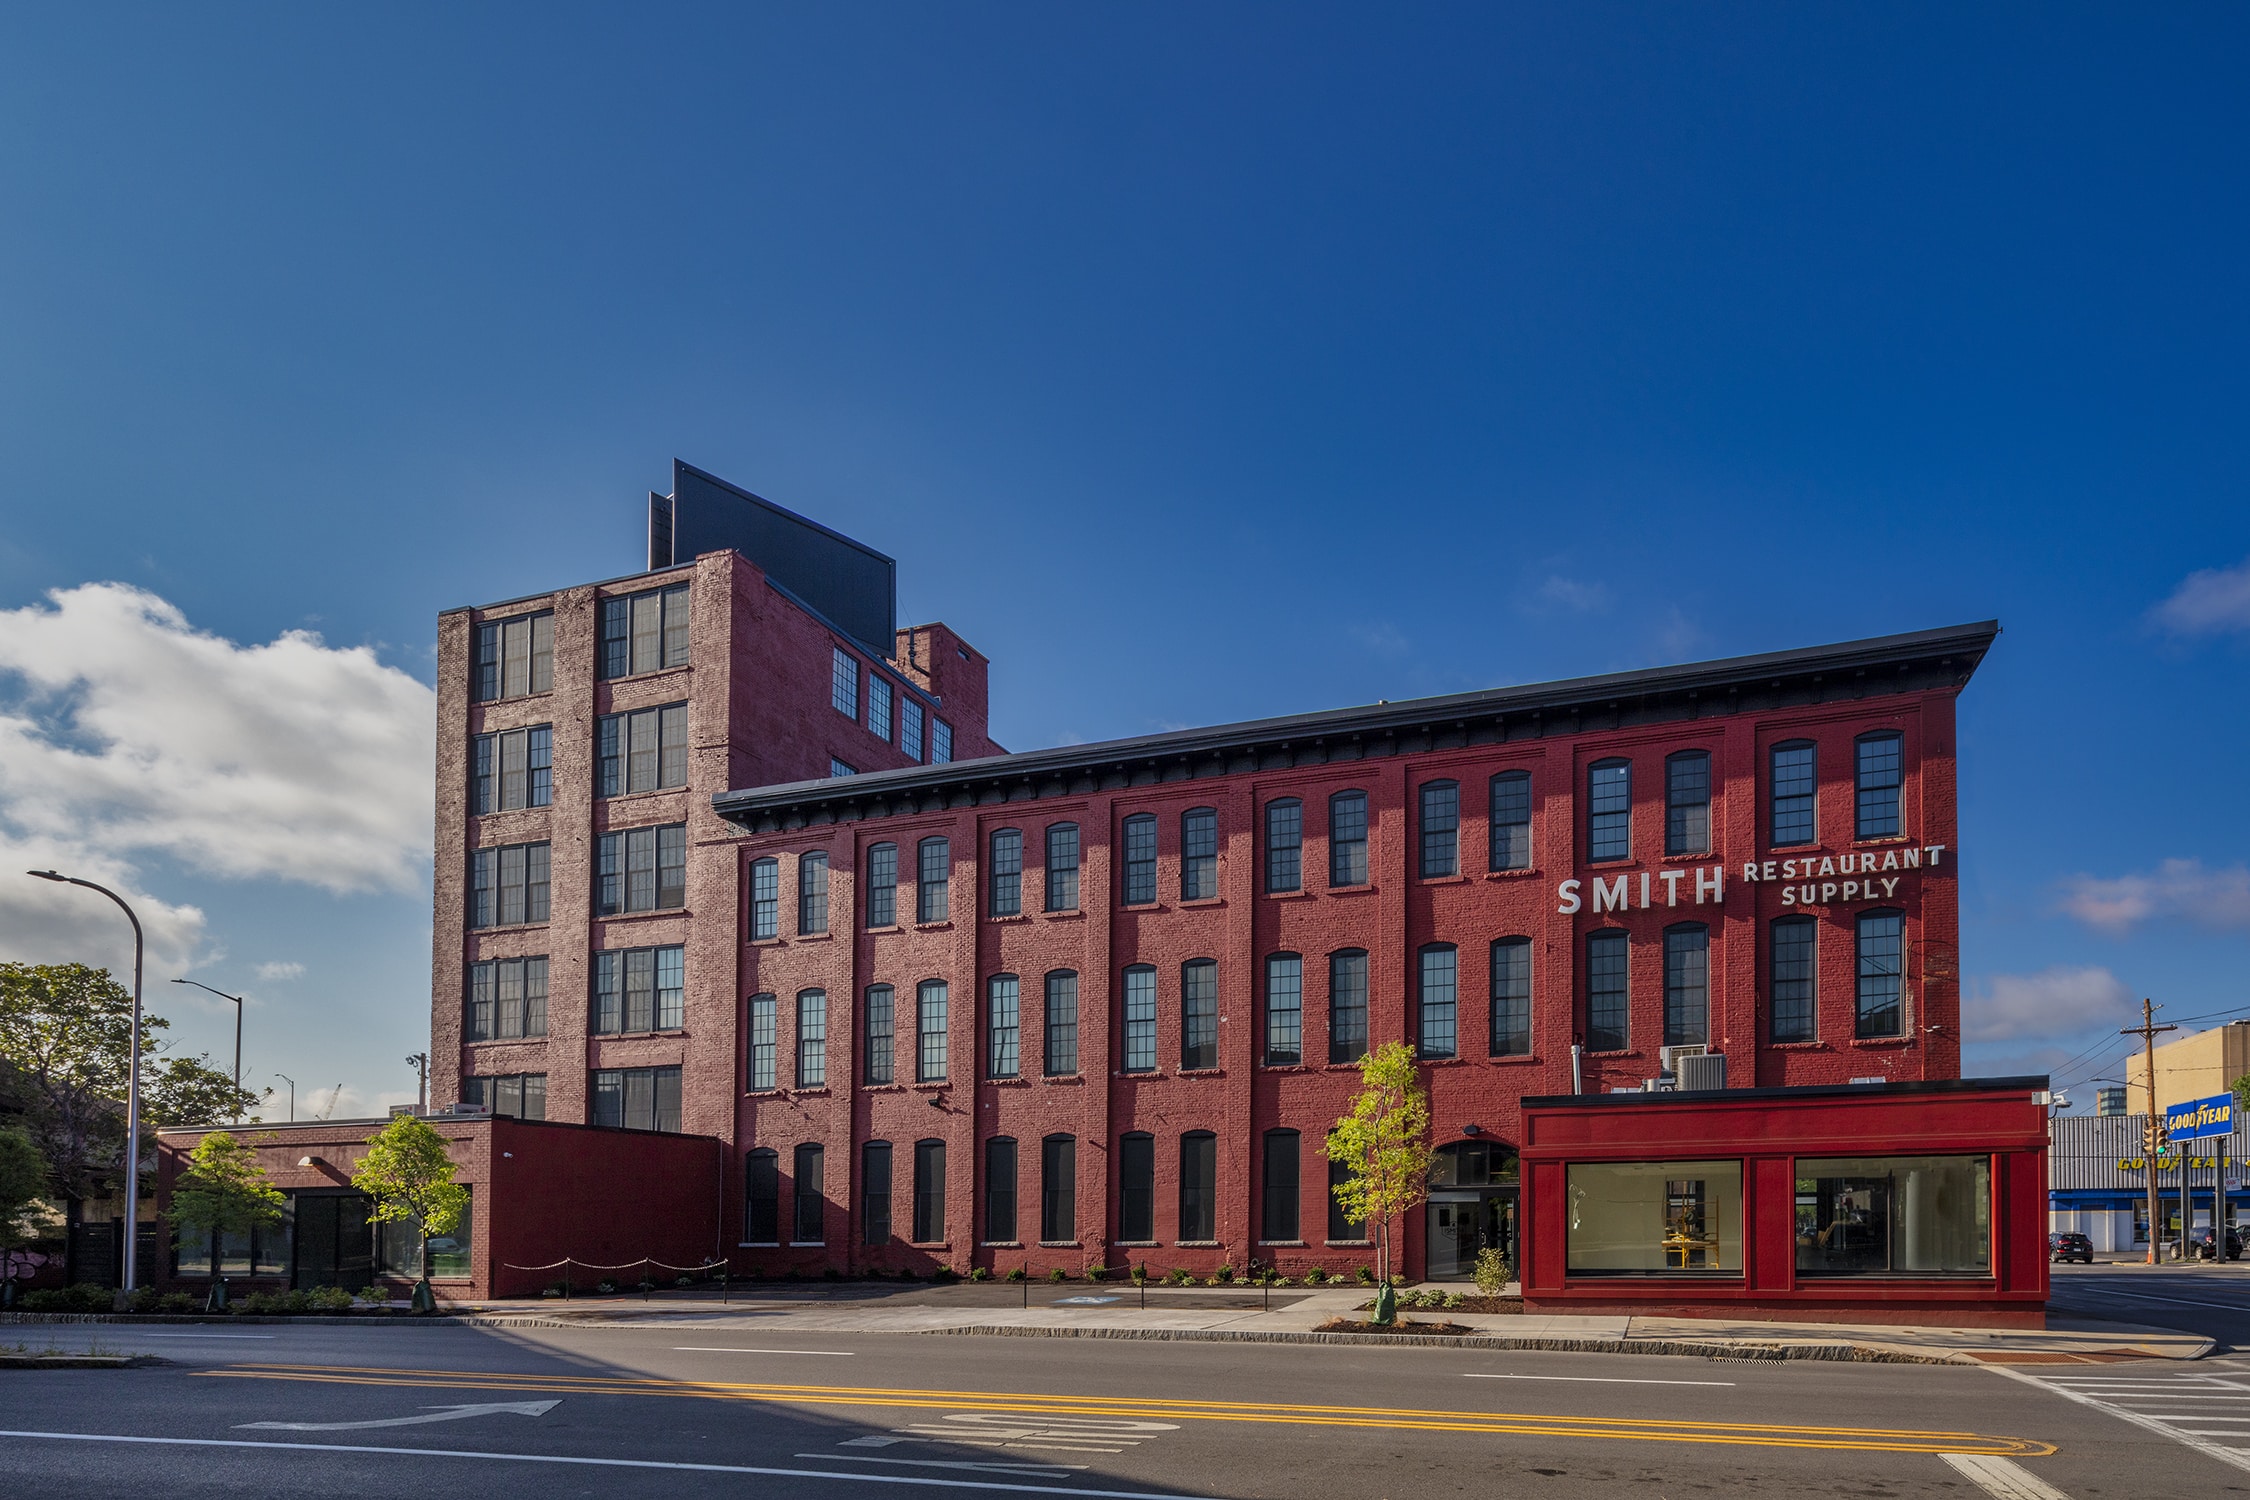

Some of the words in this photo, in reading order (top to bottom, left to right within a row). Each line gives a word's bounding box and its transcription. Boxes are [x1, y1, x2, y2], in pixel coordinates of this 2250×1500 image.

[1743, 845, 1946, 883] RESTAURANT
[1557, 866, 1723, 914] SMITH
[1780, 877, 1900, 906] SUPPLY
[2169, 1105, 2231, 1131] GOODYEAR
[794, 1413, 1181, 1479] ONLY
